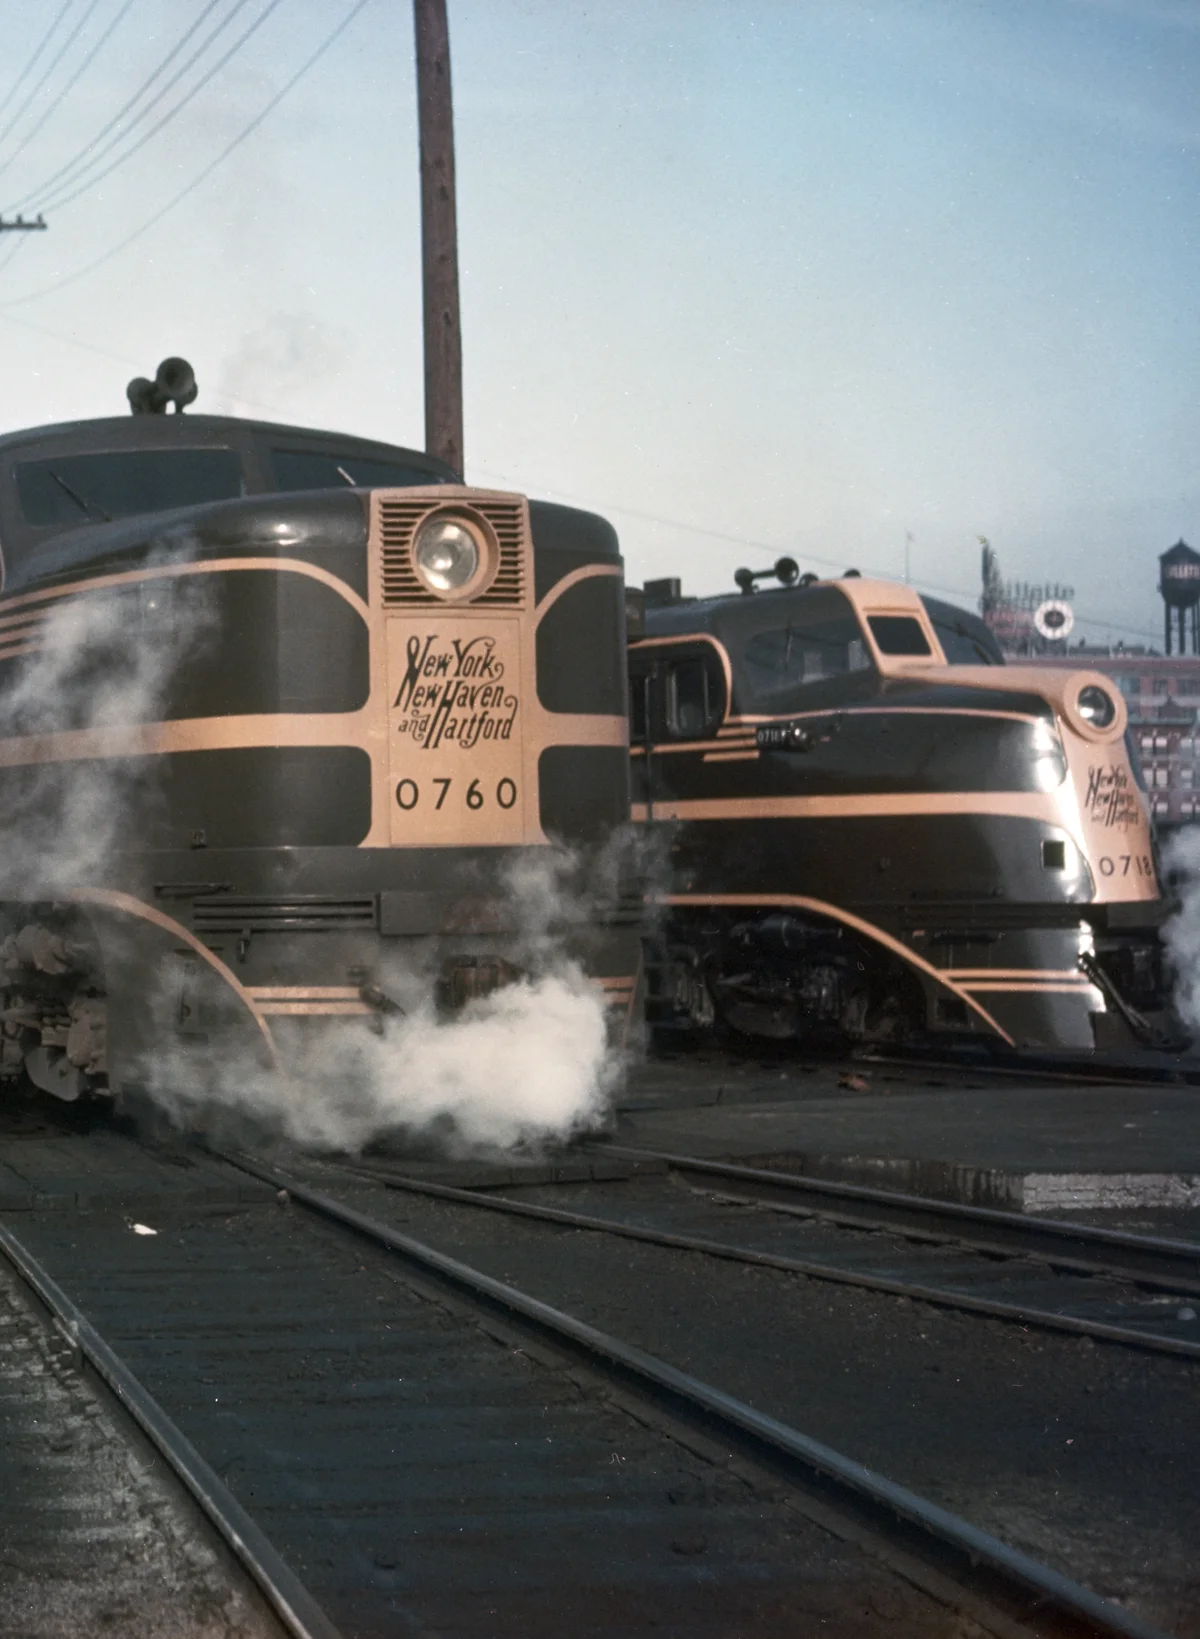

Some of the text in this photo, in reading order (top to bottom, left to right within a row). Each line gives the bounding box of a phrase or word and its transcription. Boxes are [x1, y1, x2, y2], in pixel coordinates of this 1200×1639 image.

[406, 635, 504, 680] New York
[393, 672, 504, 712] New Haven
[398, 697, 518, 749] and Hartford
[396, 777, 517, 810] 0760
